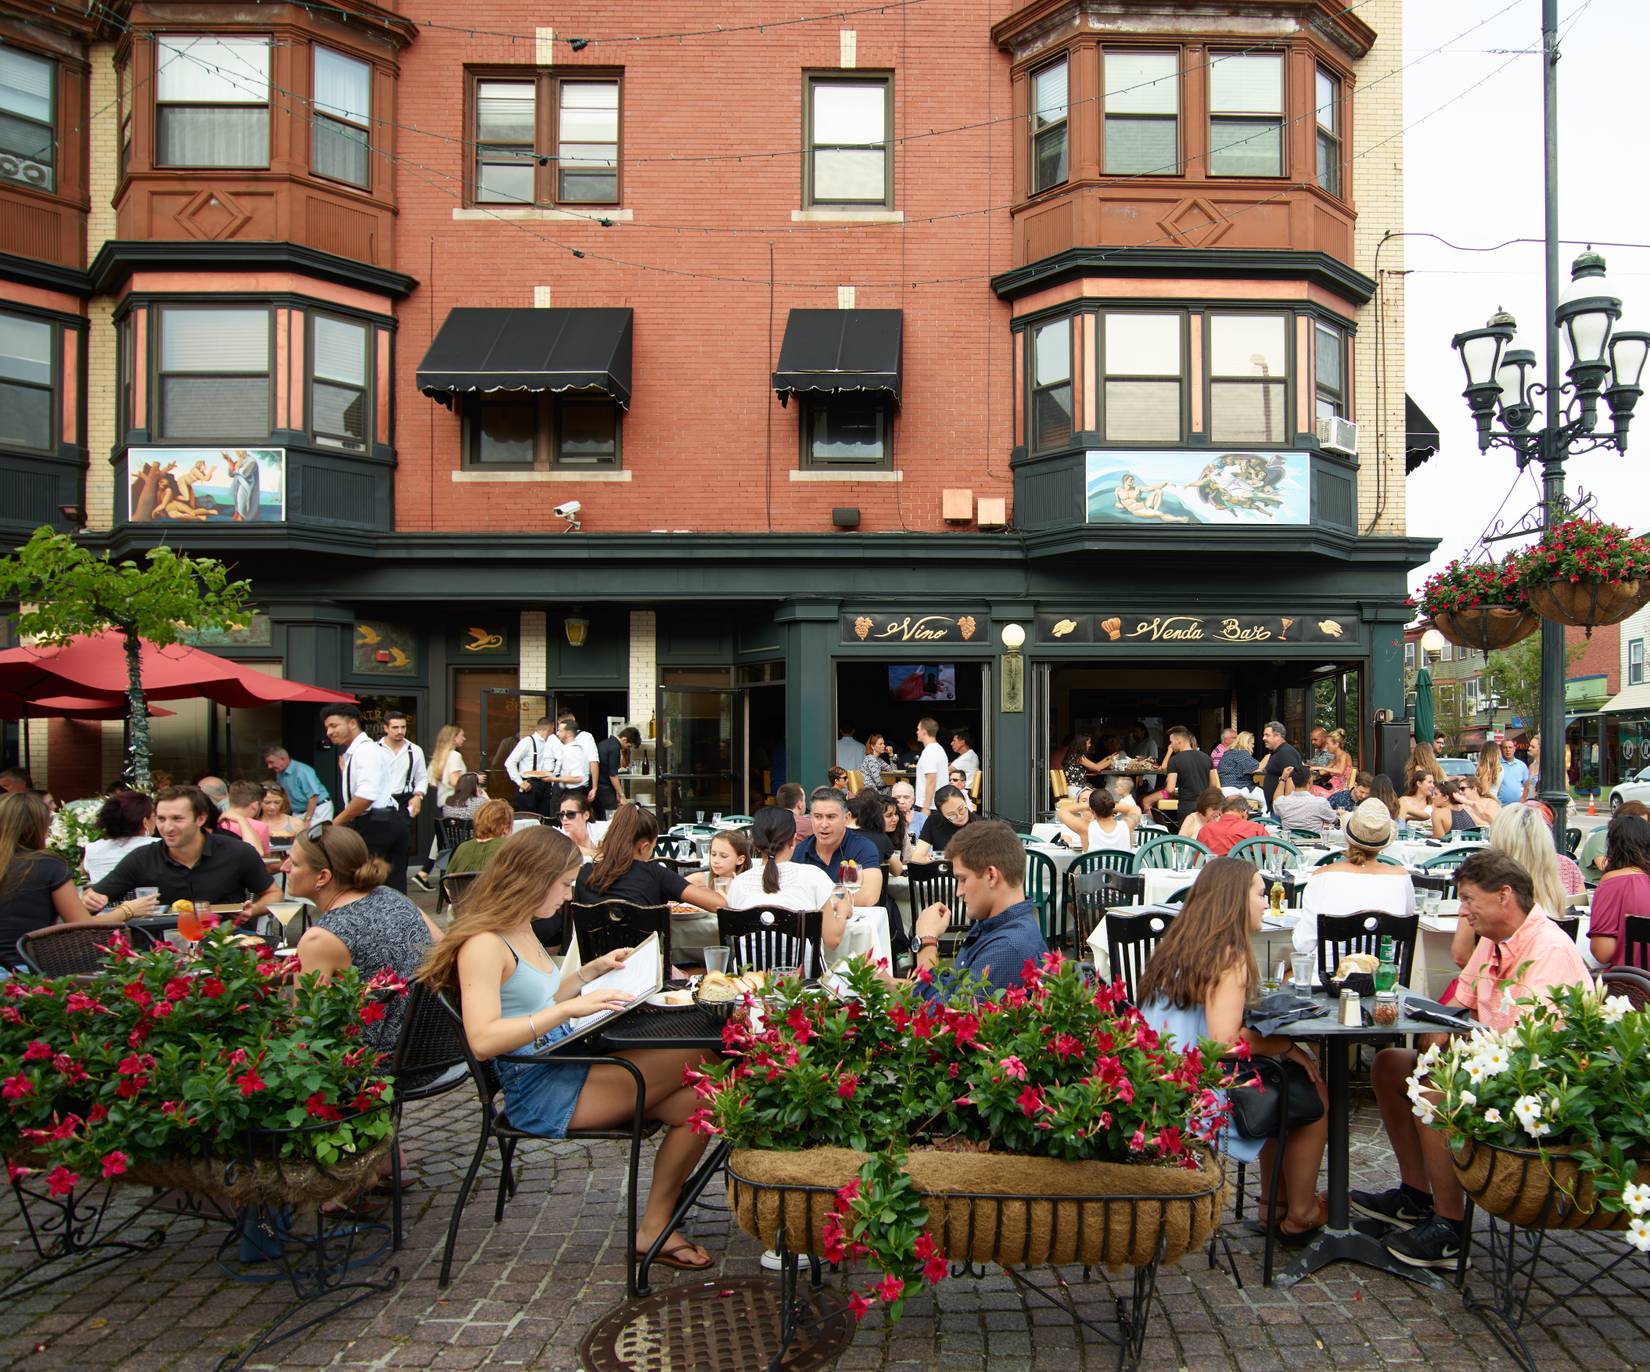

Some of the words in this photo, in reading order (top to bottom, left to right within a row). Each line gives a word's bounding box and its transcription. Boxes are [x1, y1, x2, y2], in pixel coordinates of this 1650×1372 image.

[873, 616, 954, 641] Vino
[1125, 616, 1206, 641] Venda
[1212, 618, 1271, 642] Bar
